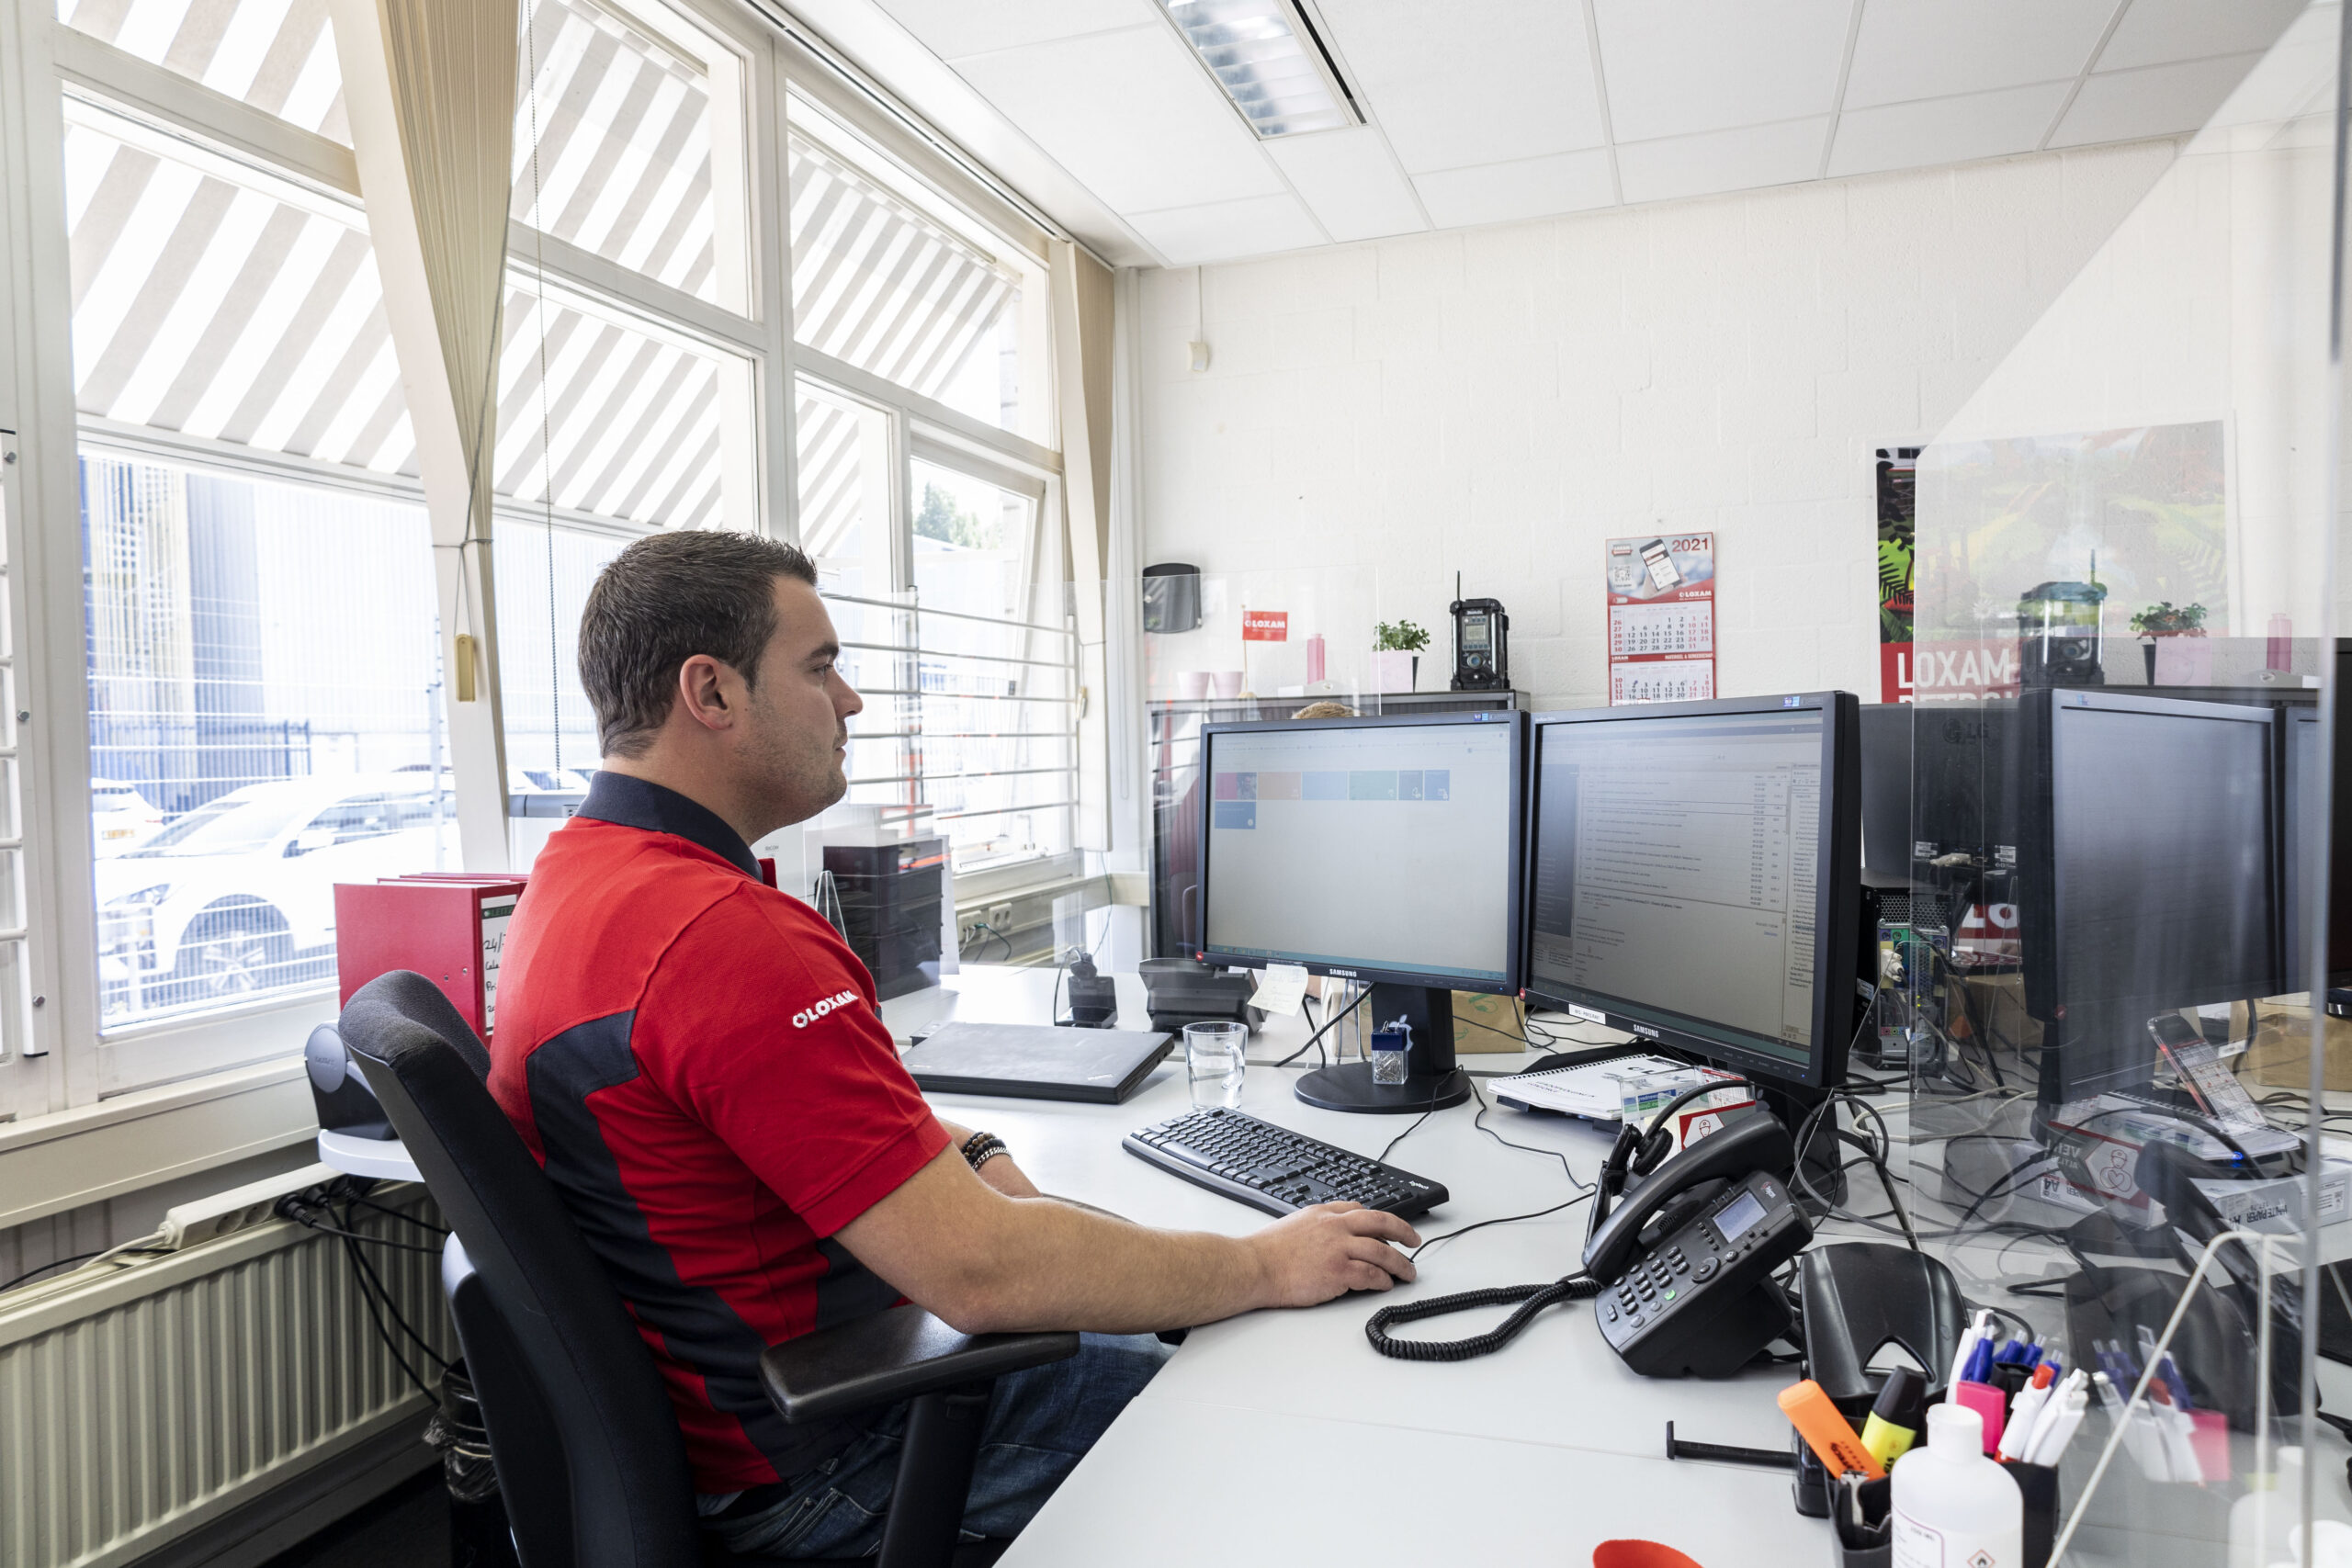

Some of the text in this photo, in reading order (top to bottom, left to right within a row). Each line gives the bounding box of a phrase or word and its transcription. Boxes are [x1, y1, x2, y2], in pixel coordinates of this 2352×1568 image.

[1672, 537, 1708, 552] 2021
[1252, 620, 1285, 628] LOXAM
[1897, 648, 2010, 689] LOXAM
[1329, 969, 1357, 977] SAMSUNG
[1634, 1024, 1659, 1038] SAMSUNG
[2044, 1178, 2059, 1191] A4
